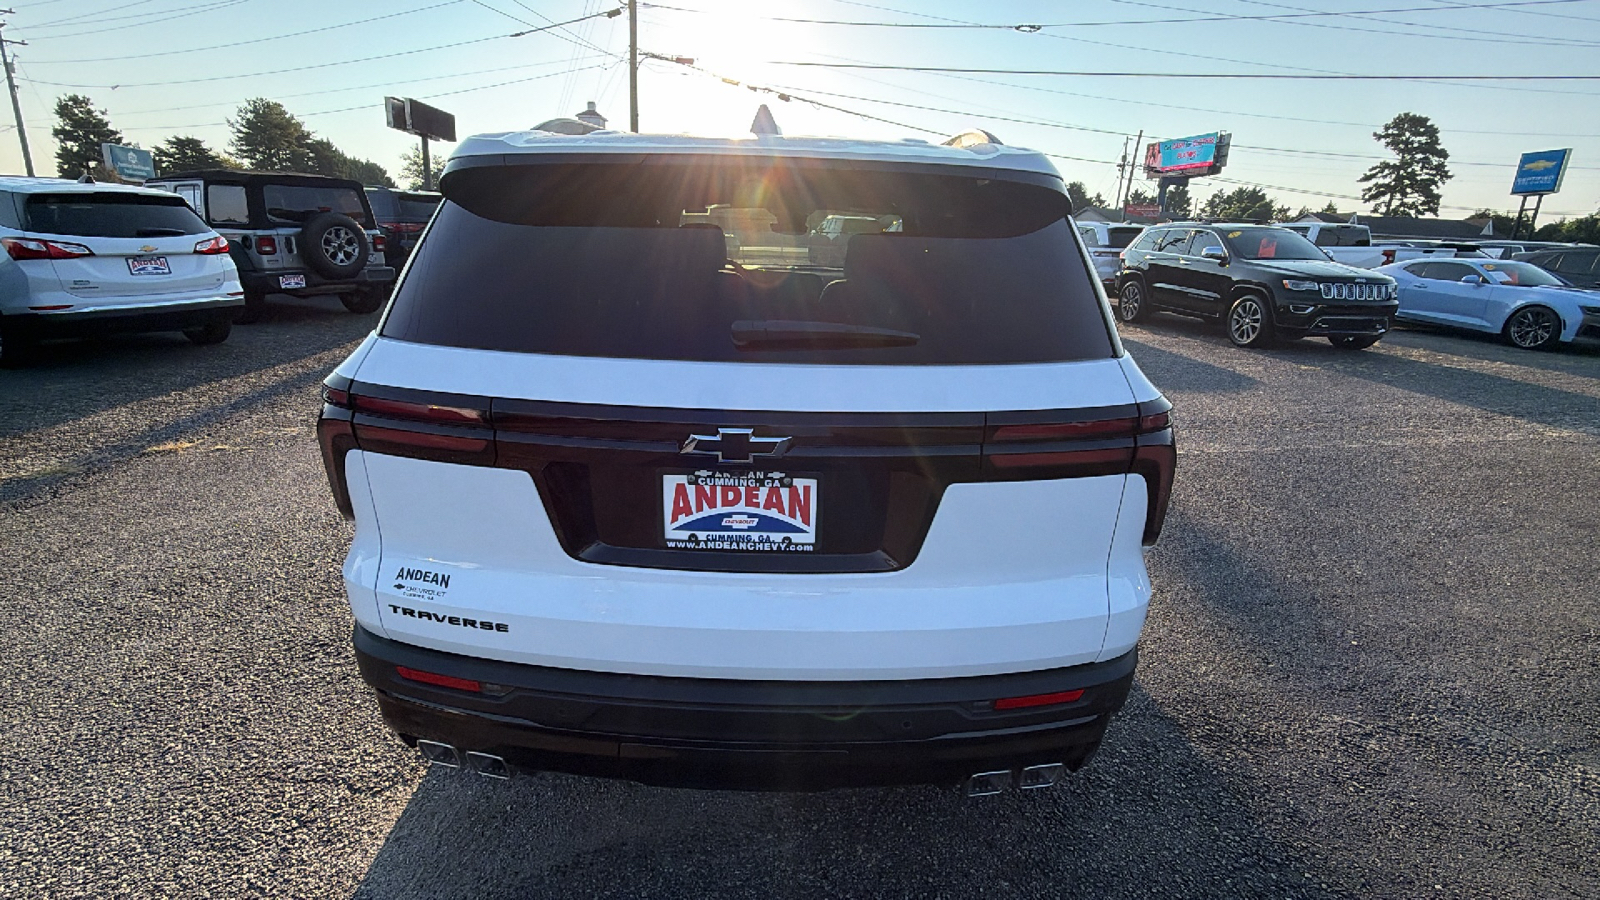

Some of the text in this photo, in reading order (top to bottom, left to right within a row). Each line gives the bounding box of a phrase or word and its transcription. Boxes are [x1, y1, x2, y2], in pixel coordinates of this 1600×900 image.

[698, 477, 781, 488] CUMMING, GA
[670, 483, 811, 527] ANDEAN
[666, 541, 814, 551] www.ANDEANCHEVY.com
[395, 567, 451, 588] ANDEAN
[388, 604, 509, 633] TRAVERSE
